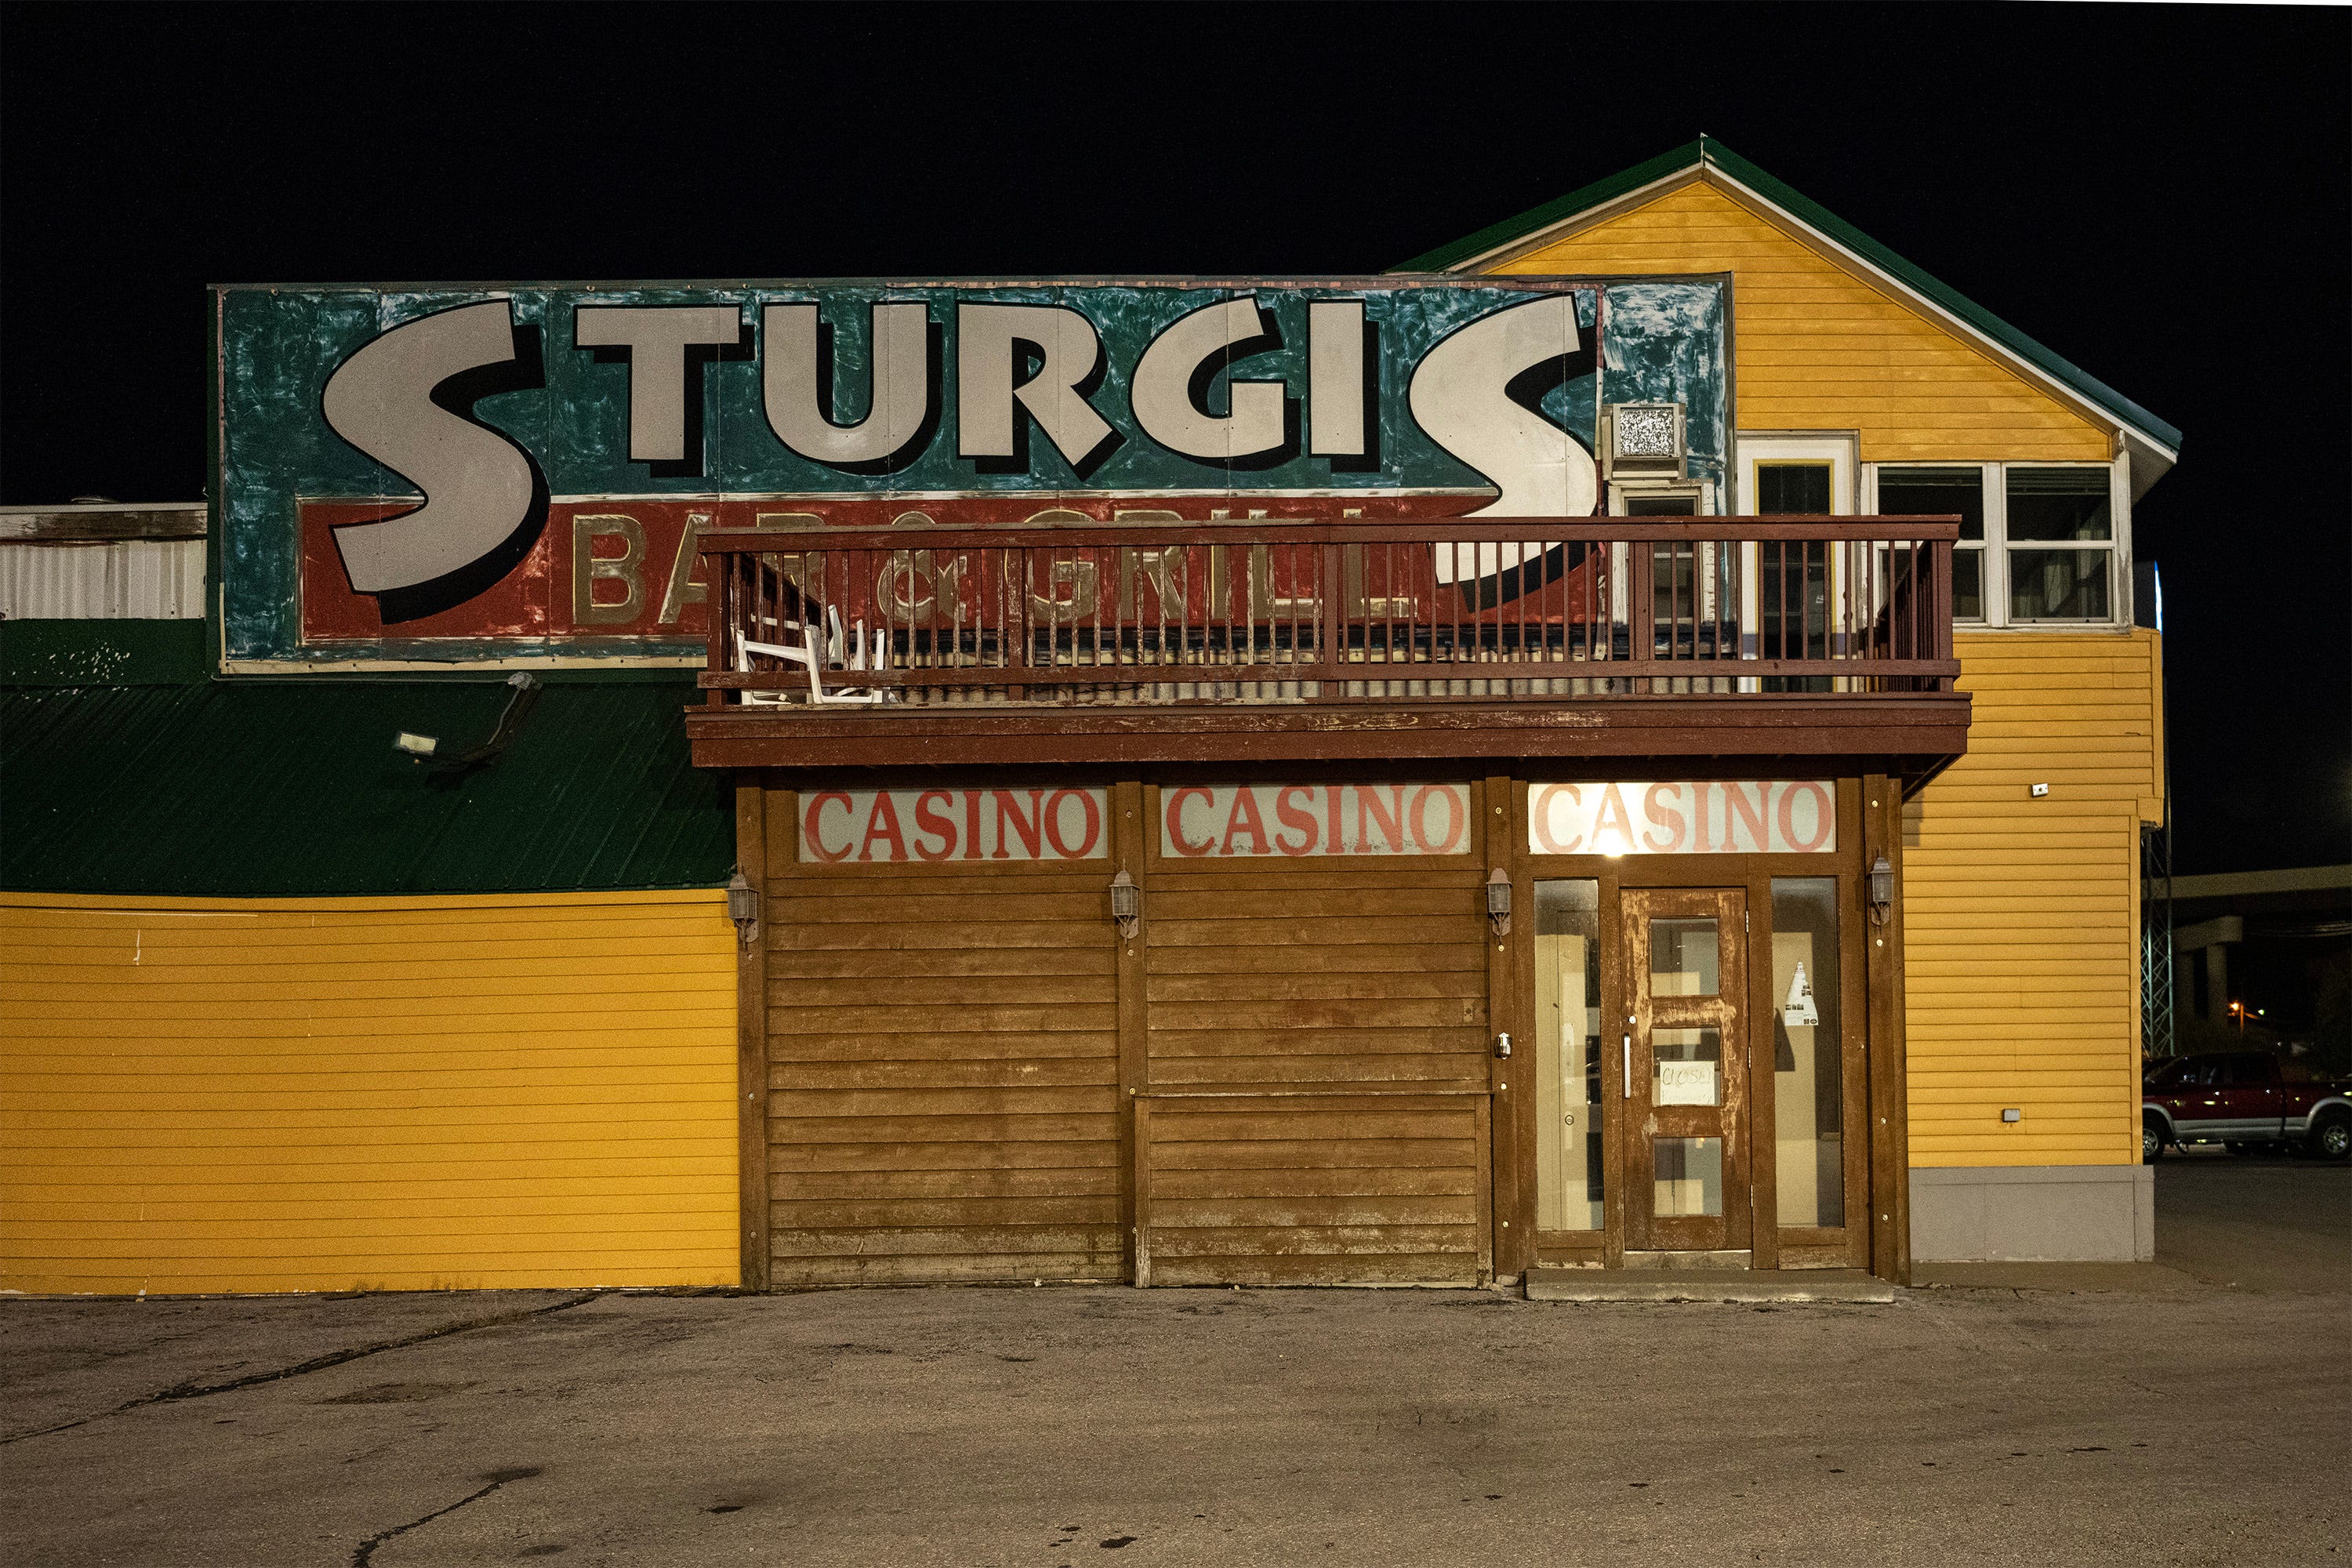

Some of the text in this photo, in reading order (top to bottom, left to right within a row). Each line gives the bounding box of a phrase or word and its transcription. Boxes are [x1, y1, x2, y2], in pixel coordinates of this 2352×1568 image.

[321, 291, 1597, 625] STURGIS
[572, 507, 1419, 625] BAR & GRILL
[805, 789, 1101, 862] CASINO
[1166, 785, 1465, 856] CASINO
[1534, 782, 1832, 854] CASINO
